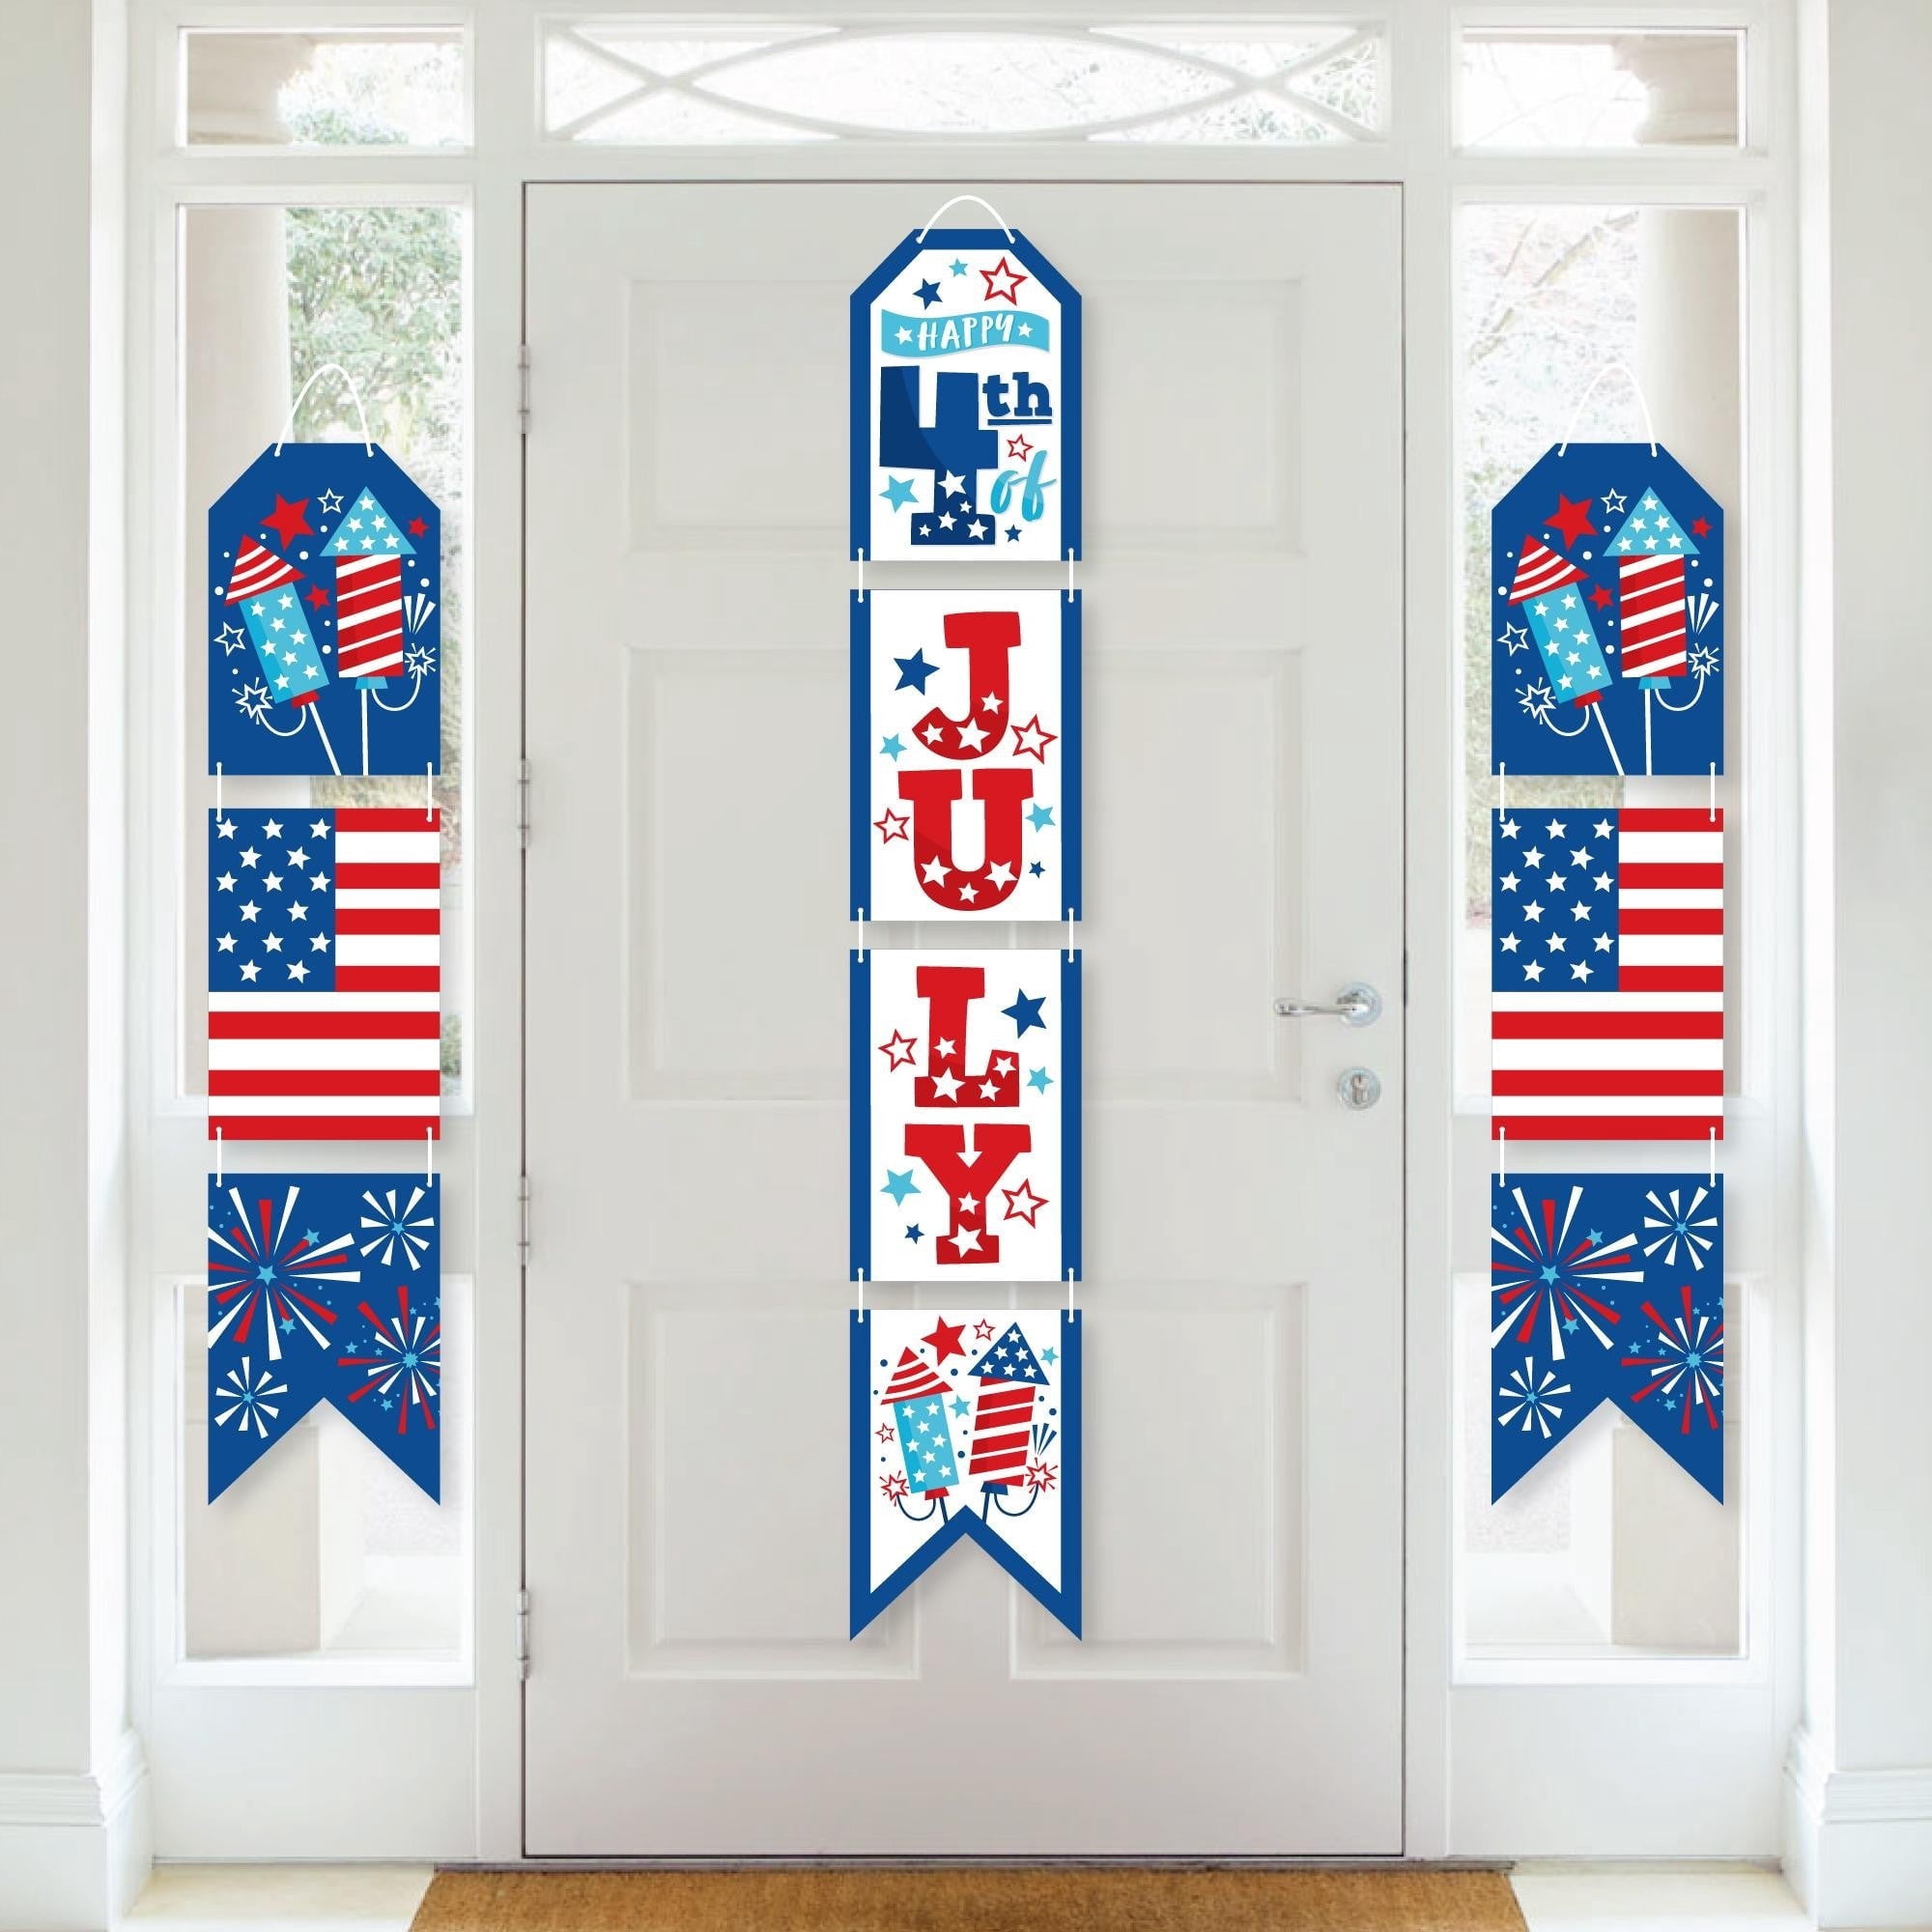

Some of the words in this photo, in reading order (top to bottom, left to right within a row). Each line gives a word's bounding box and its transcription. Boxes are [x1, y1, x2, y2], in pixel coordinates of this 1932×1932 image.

[917, 313, 1015, 351] HAPPY
[879, 365, 1053, 545] 4th
[990, 450, 1057, 522] of
